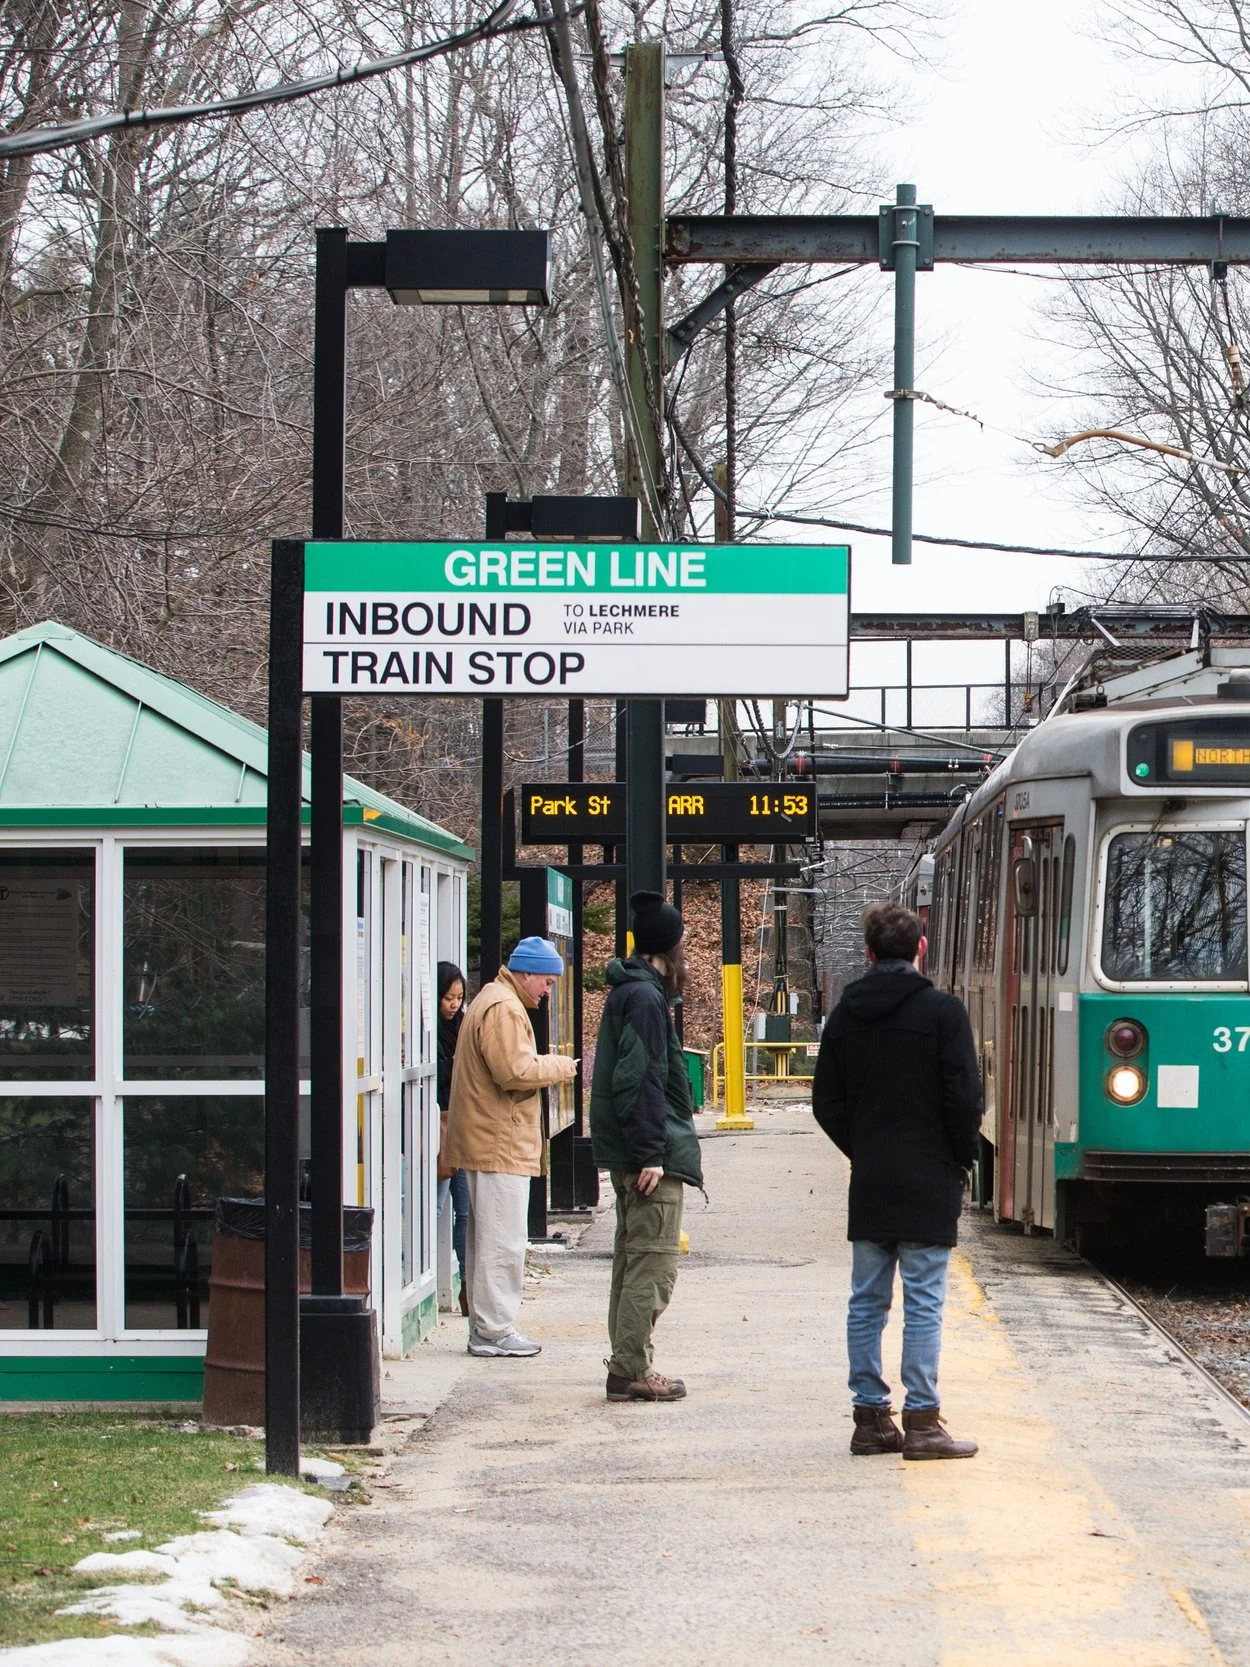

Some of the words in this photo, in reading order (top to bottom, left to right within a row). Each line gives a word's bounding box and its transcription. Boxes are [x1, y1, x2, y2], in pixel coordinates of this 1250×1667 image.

[444, 550, 596, 587] GREEN
[610, 551, 707, 587] LINE
[326, 602, 531, 636] INBOUND
[563, 604, 584, 617] TO
[589, 604, 680, 617] LECHMERE
[563, 622, 587, 635] VIA
[593, 622, 634, 635] PARK
[323, 651, 453, 685] TRAIN
[468, 651, 585, 686] STOP
[1196, 749, 1250, 764] NORTH
[530, 796, 578, 815] Park
[588, 796, 611, 815] St
[668, 796, 704, 815] ARR
[750, 796, 808, 815] 11:53
